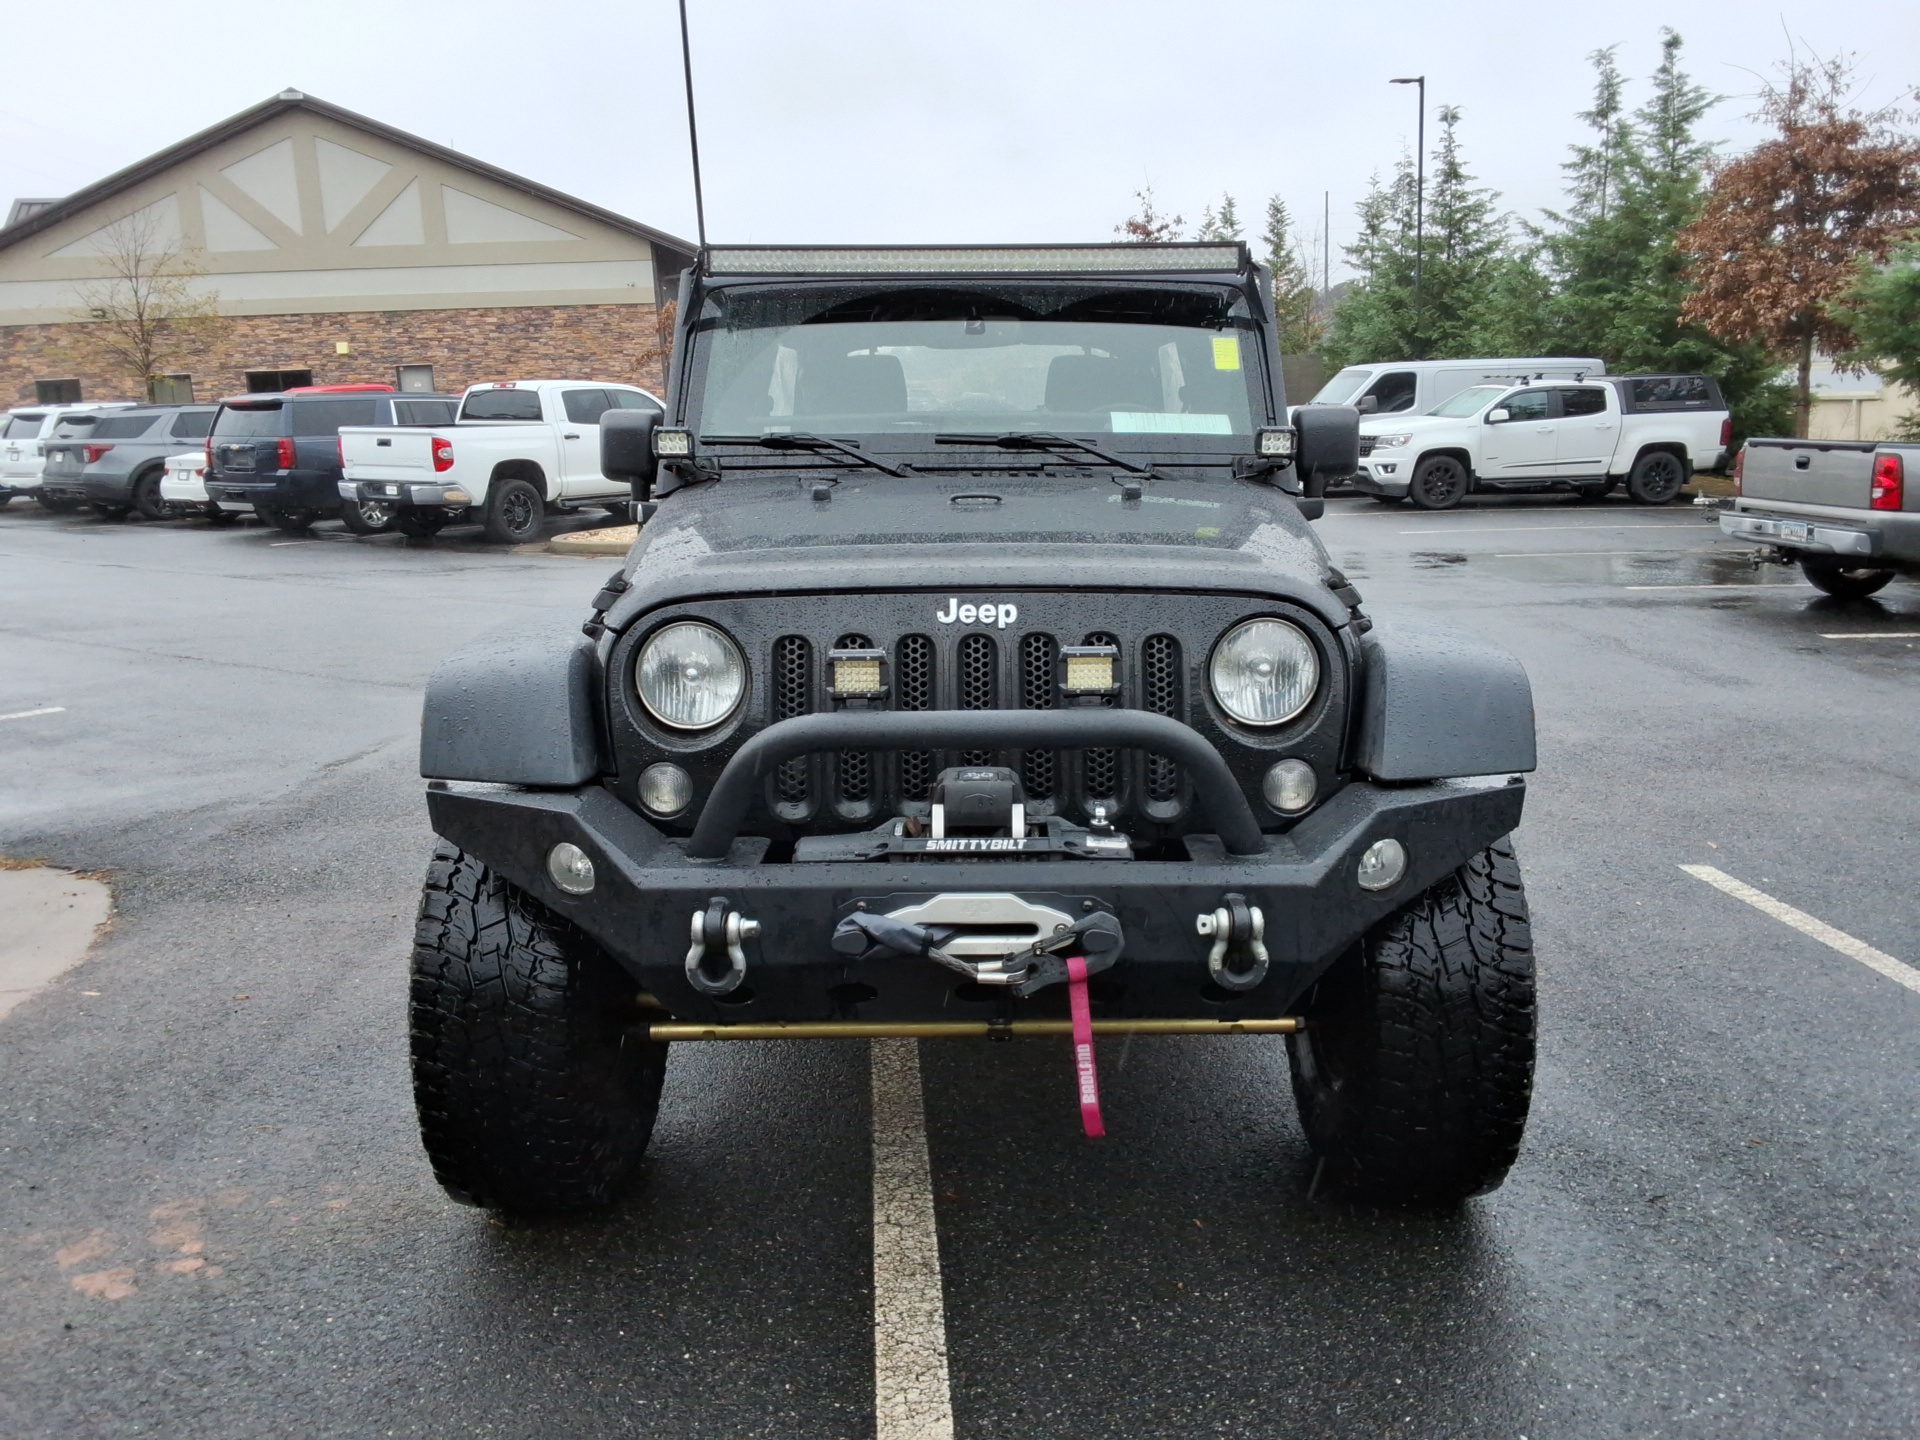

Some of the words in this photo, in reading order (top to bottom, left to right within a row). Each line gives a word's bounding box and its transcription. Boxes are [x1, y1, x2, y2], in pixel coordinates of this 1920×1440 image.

[937, 598, 1018, 628] Jeep
[926, 839, 1027, 850] SMITTYBILT
[1077, 1043, 1096, 1104] BADLAND
